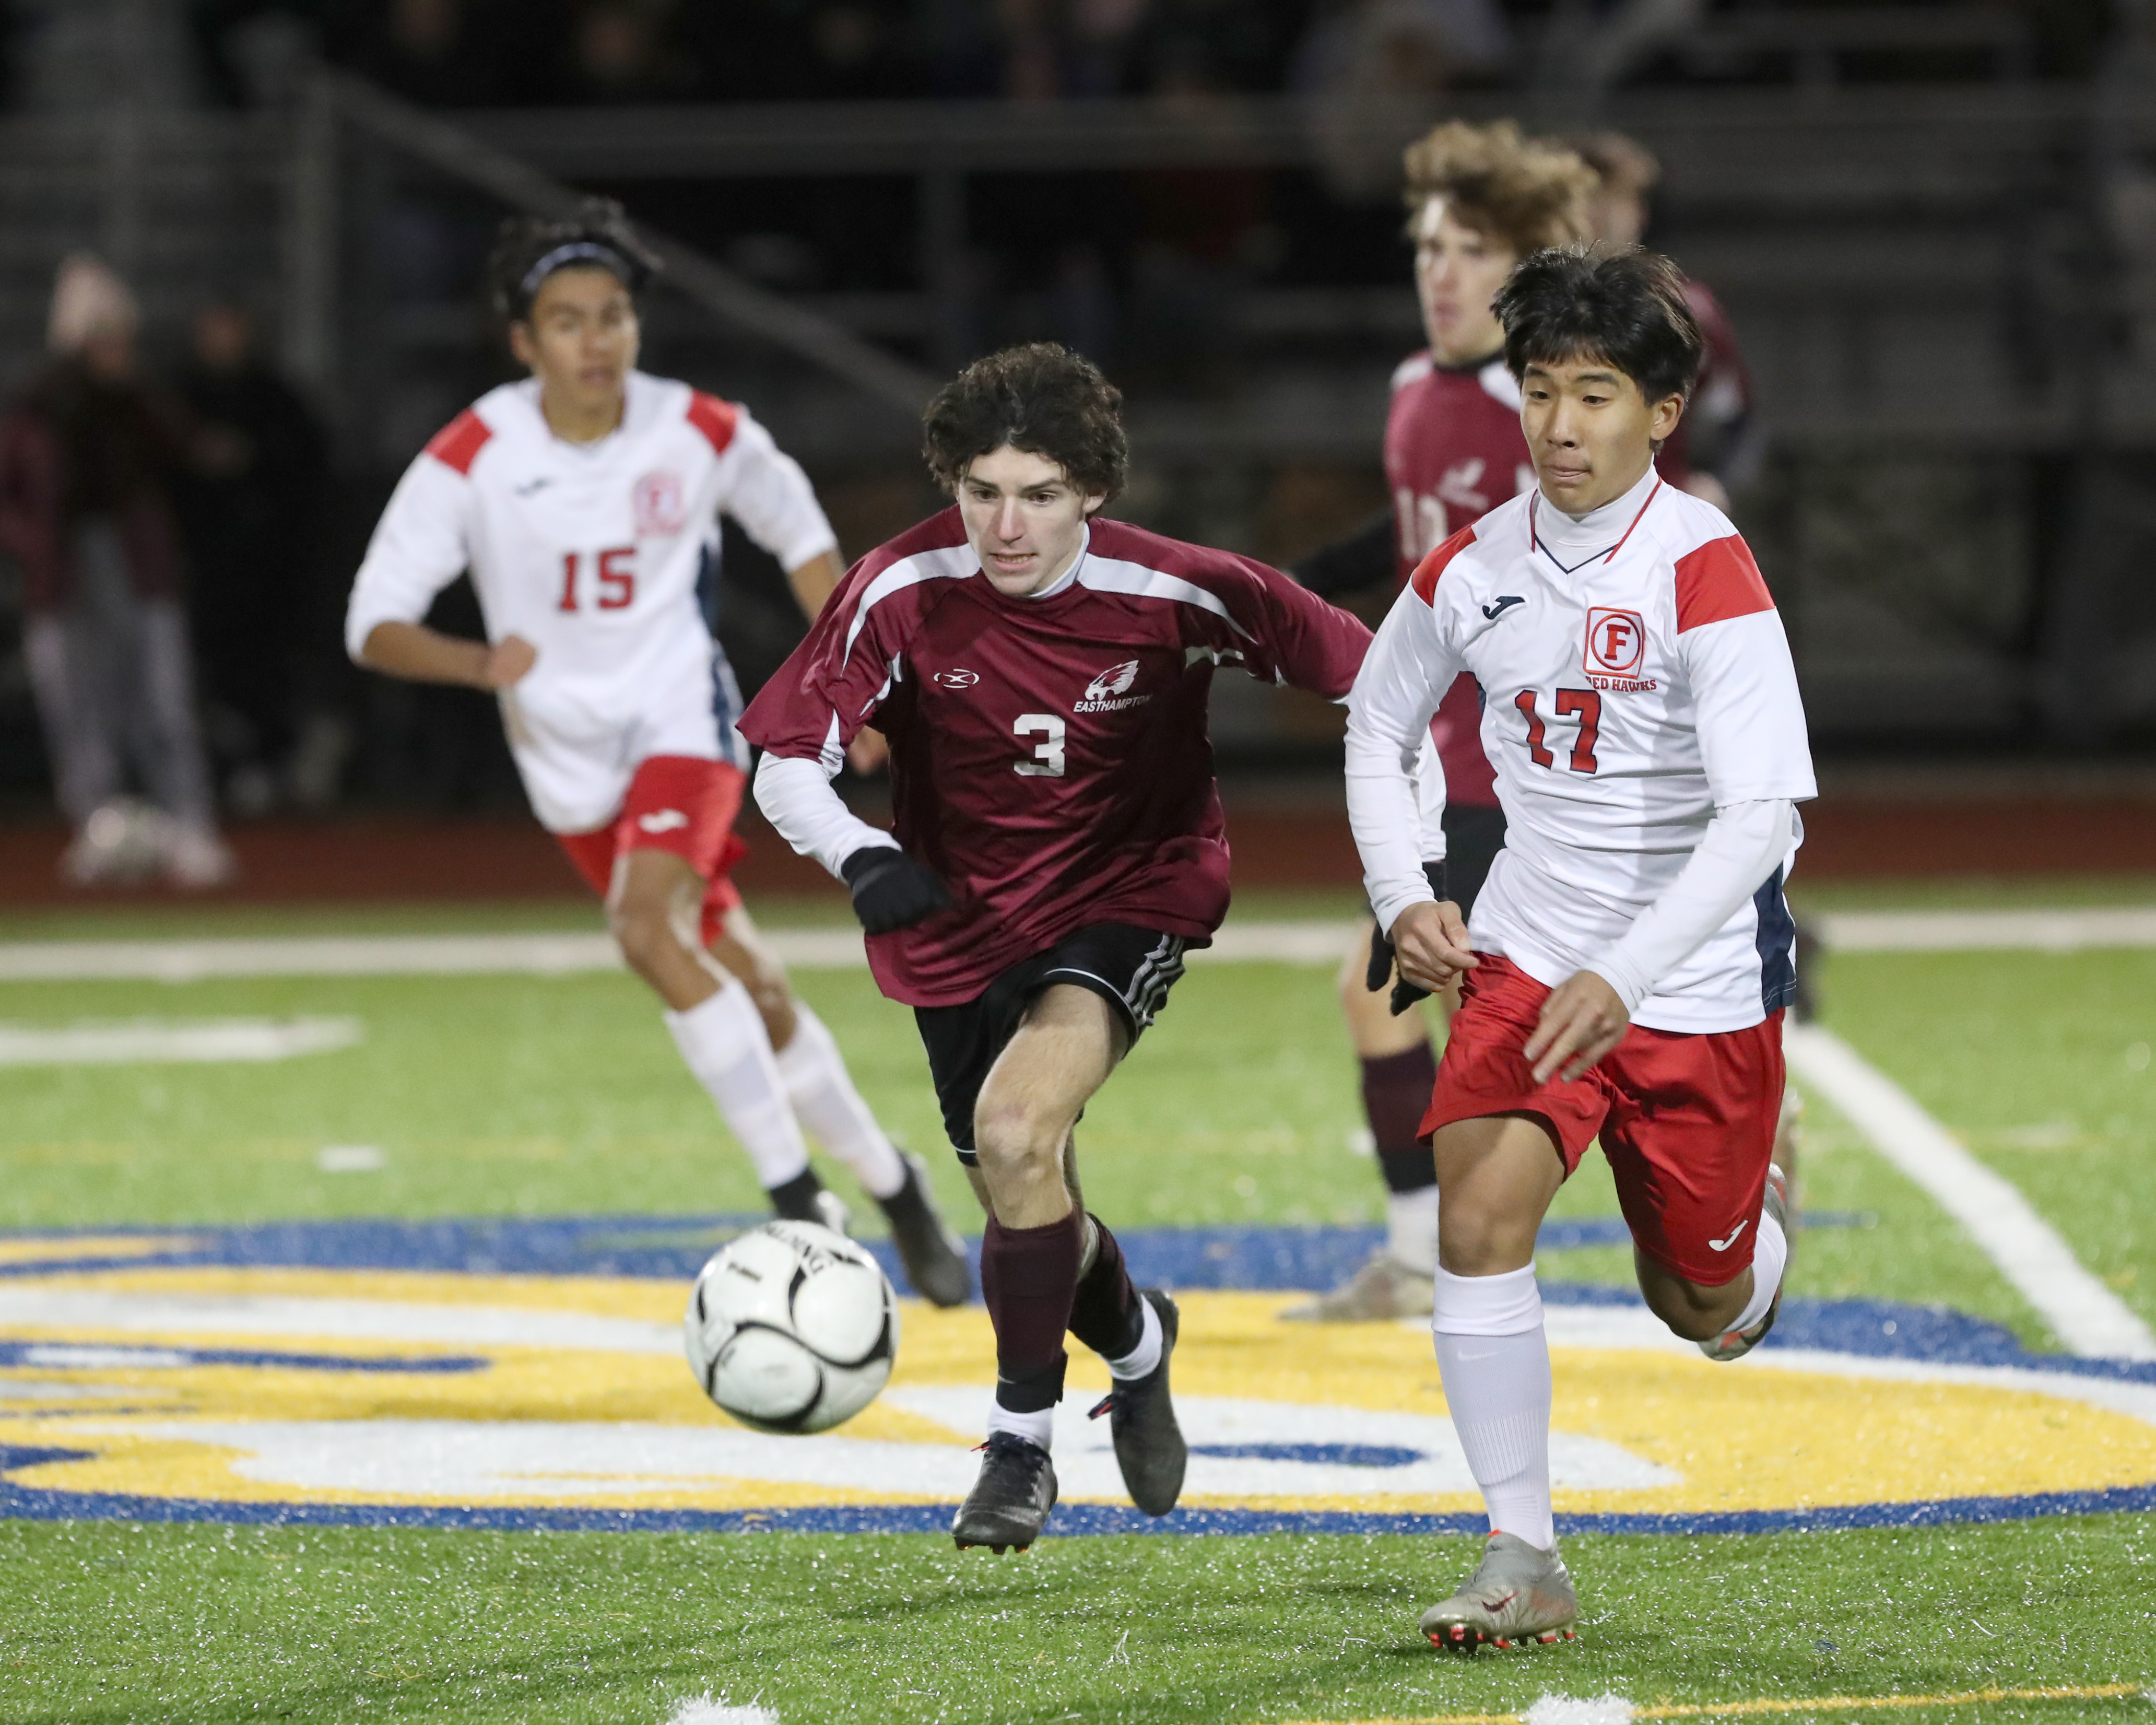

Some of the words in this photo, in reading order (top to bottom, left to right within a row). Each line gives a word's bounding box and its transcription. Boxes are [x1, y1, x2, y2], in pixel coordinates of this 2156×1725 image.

[560, 547, 635, 611] 15
[1605, 624, 1630, 660] F
[1612, 679, 1657, 693] HAWKS
[1014, 713, 1066, 777] 3
[1515, 688, 1601, 774] 17
